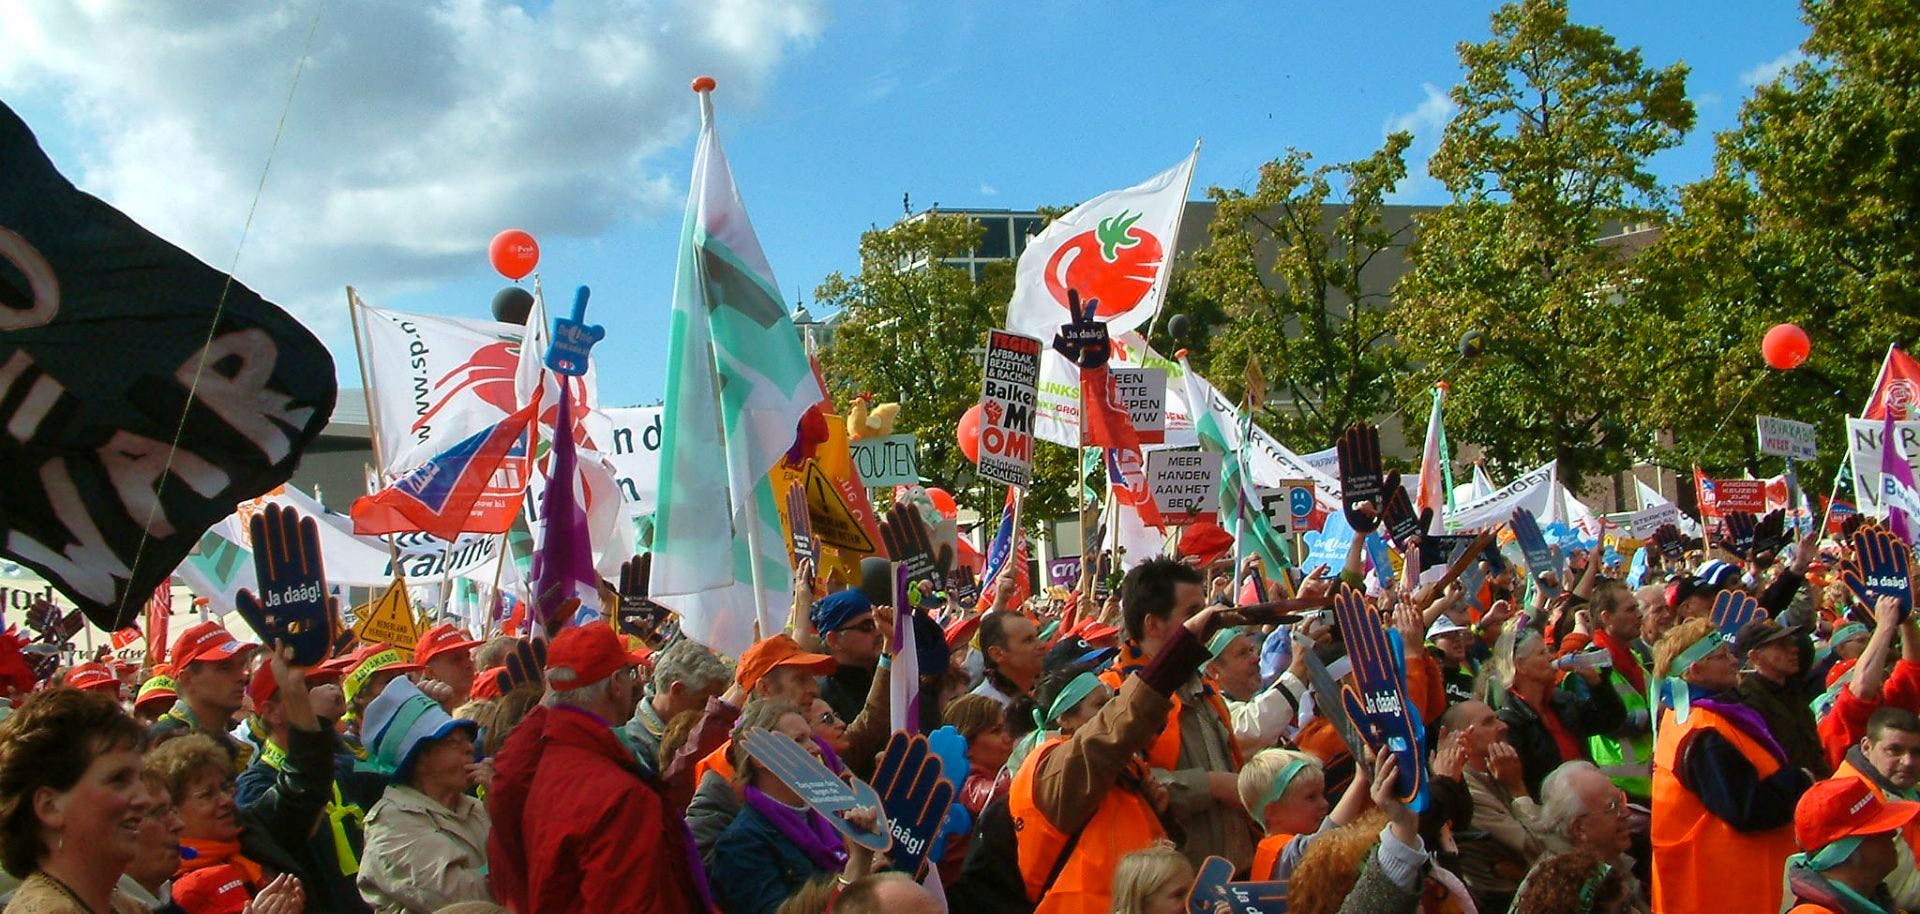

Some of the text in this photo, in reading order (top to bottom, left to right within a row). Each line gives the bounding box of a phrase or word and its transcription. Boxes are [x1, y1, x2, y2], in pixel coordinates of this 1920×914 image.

[1067, 330, 1078, 339] Ja
[992, 333, 1040, 354] TEGEN
[989, 357, 1035, 377] BEZETTING
[996, 369, 1034, 386] RACISME
[1168, 457, 1202, 467] MEER
[1157, 471, 1211, 481] HANDEN
[1155, 485, 1211, 494] AAN HET
[1866, 575, 1878, 586] Ja
[265, 590, 281, 608] Ja
[1364, 692, 1378, 715] Ja
